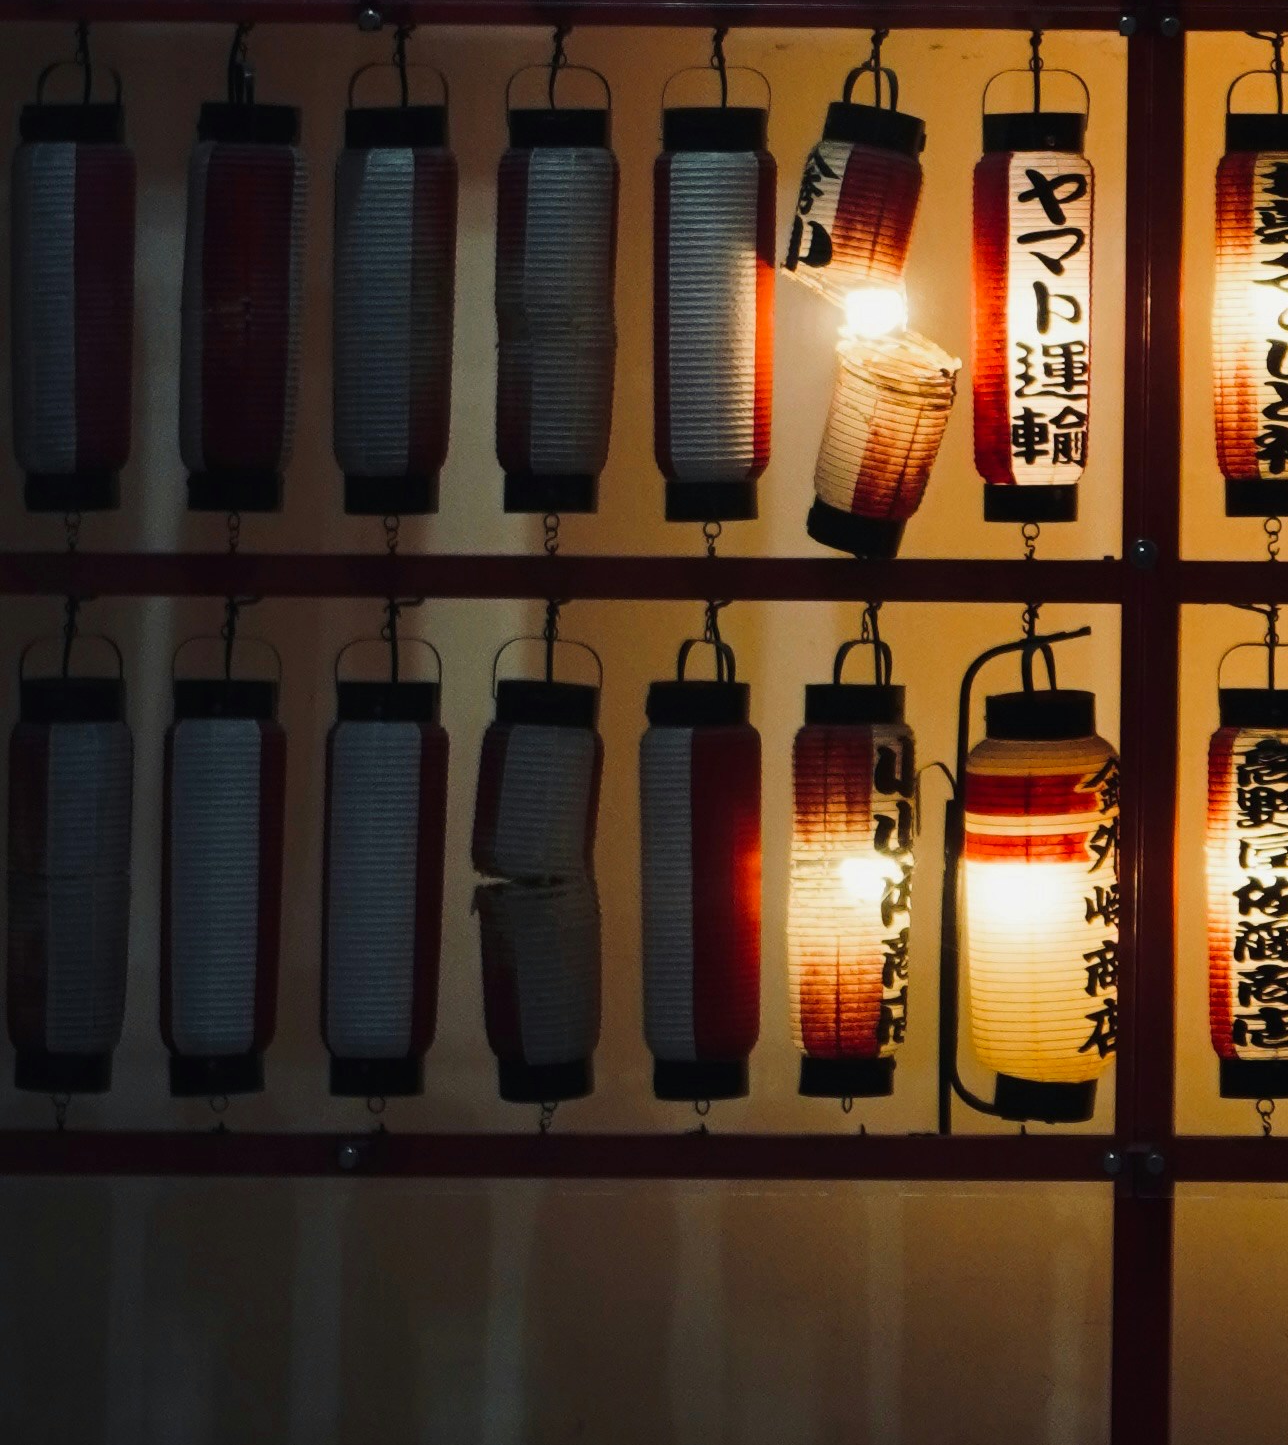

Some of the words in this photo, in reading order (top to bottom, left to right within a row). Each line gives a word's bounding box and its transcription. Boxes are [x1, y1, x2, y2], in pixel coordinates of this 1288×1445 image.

[1010, 168, 1089, 467] ヤマト運輸
